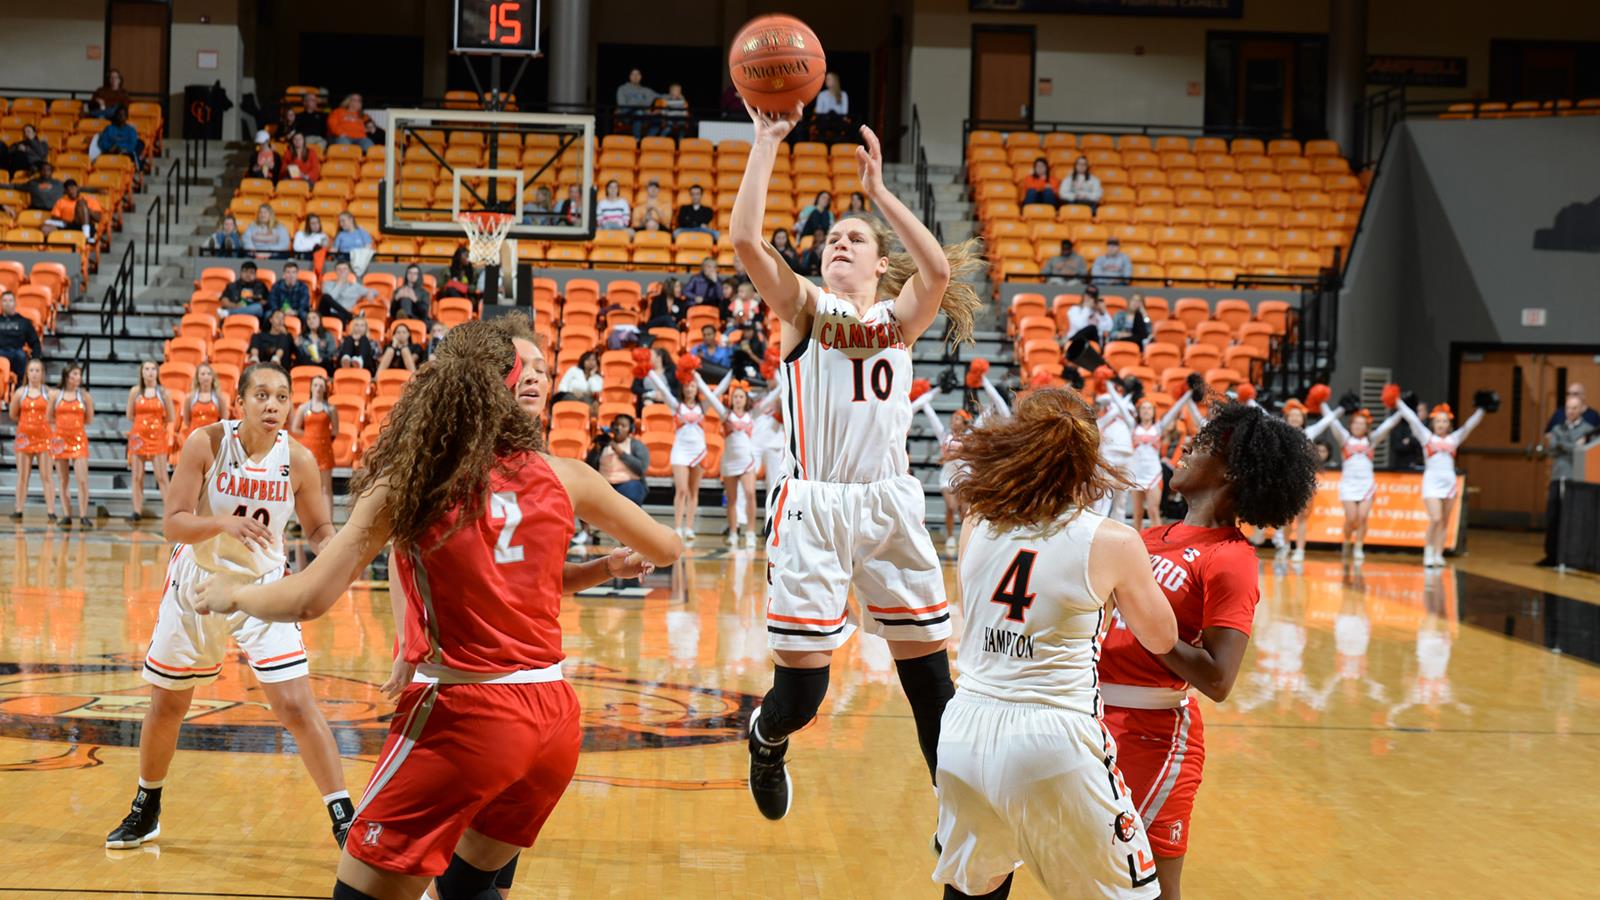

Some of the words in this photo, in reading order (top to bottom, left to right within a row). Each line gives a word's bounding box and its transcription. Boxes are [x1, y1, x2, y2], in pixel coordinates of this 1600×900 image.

[489, 2, 522, 44] 15
[743, 59, 809, 80] SPALDING
[848, 357, 894, 402] 10
[490, 491, 525, 564] 2
[990, 548, 1038, 624] 4
[982, 625, 1035, 660] HAMPTON
